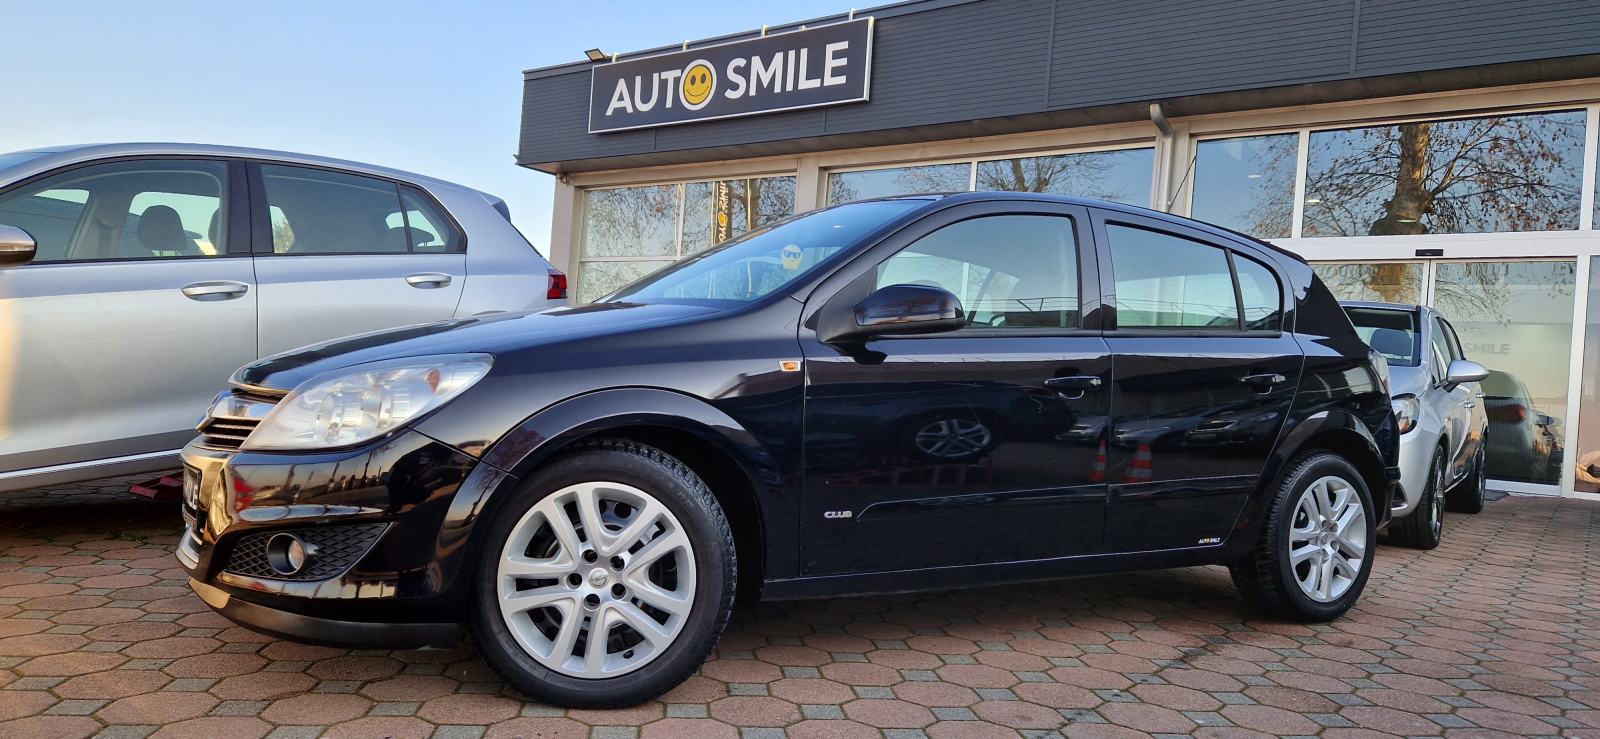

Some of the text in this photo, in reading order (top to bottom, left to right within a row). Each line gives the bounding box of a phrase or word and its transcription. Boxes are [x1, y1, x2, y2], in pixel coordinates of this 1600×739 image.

[605, 41, 849, 116] AUTO SMILE
[824, 510, 852, 518] CLUB
